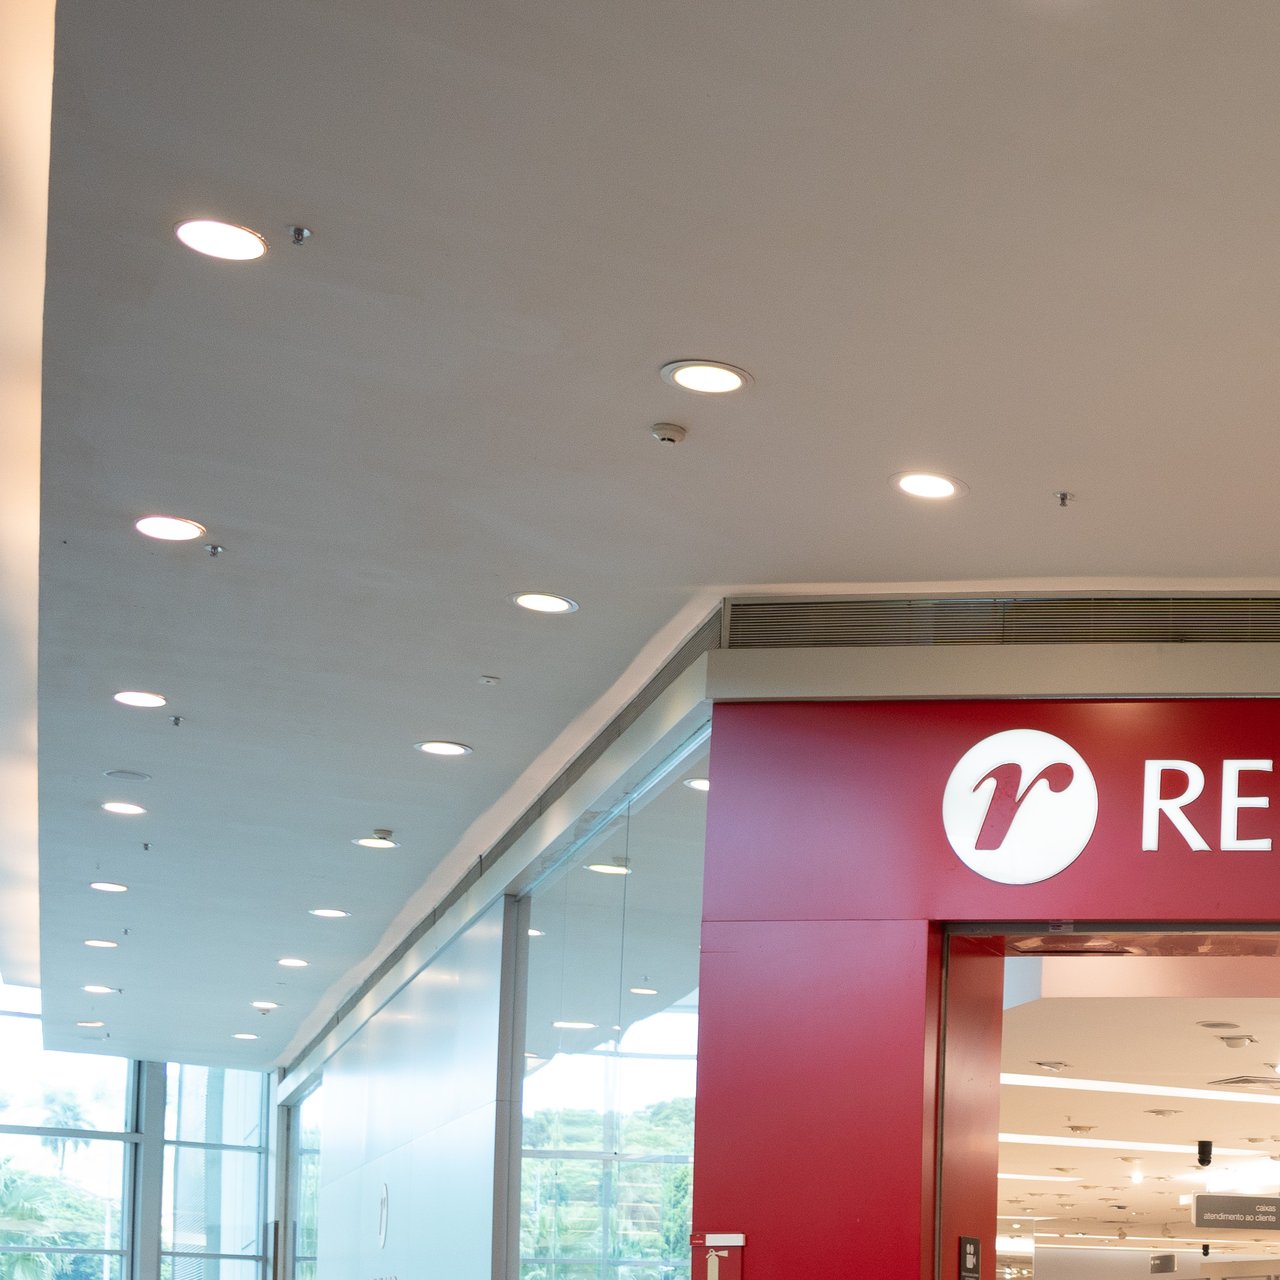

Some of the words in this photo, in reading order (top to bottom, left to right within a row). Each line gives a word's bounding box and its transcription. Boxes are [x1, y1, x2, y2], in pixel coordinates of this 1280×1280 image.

[1255, 1204, 1277, 1212] caixas
[1203, 1212, 1244, 1221] atendimento
[1255, 1214, 1277, 1222] cliente
